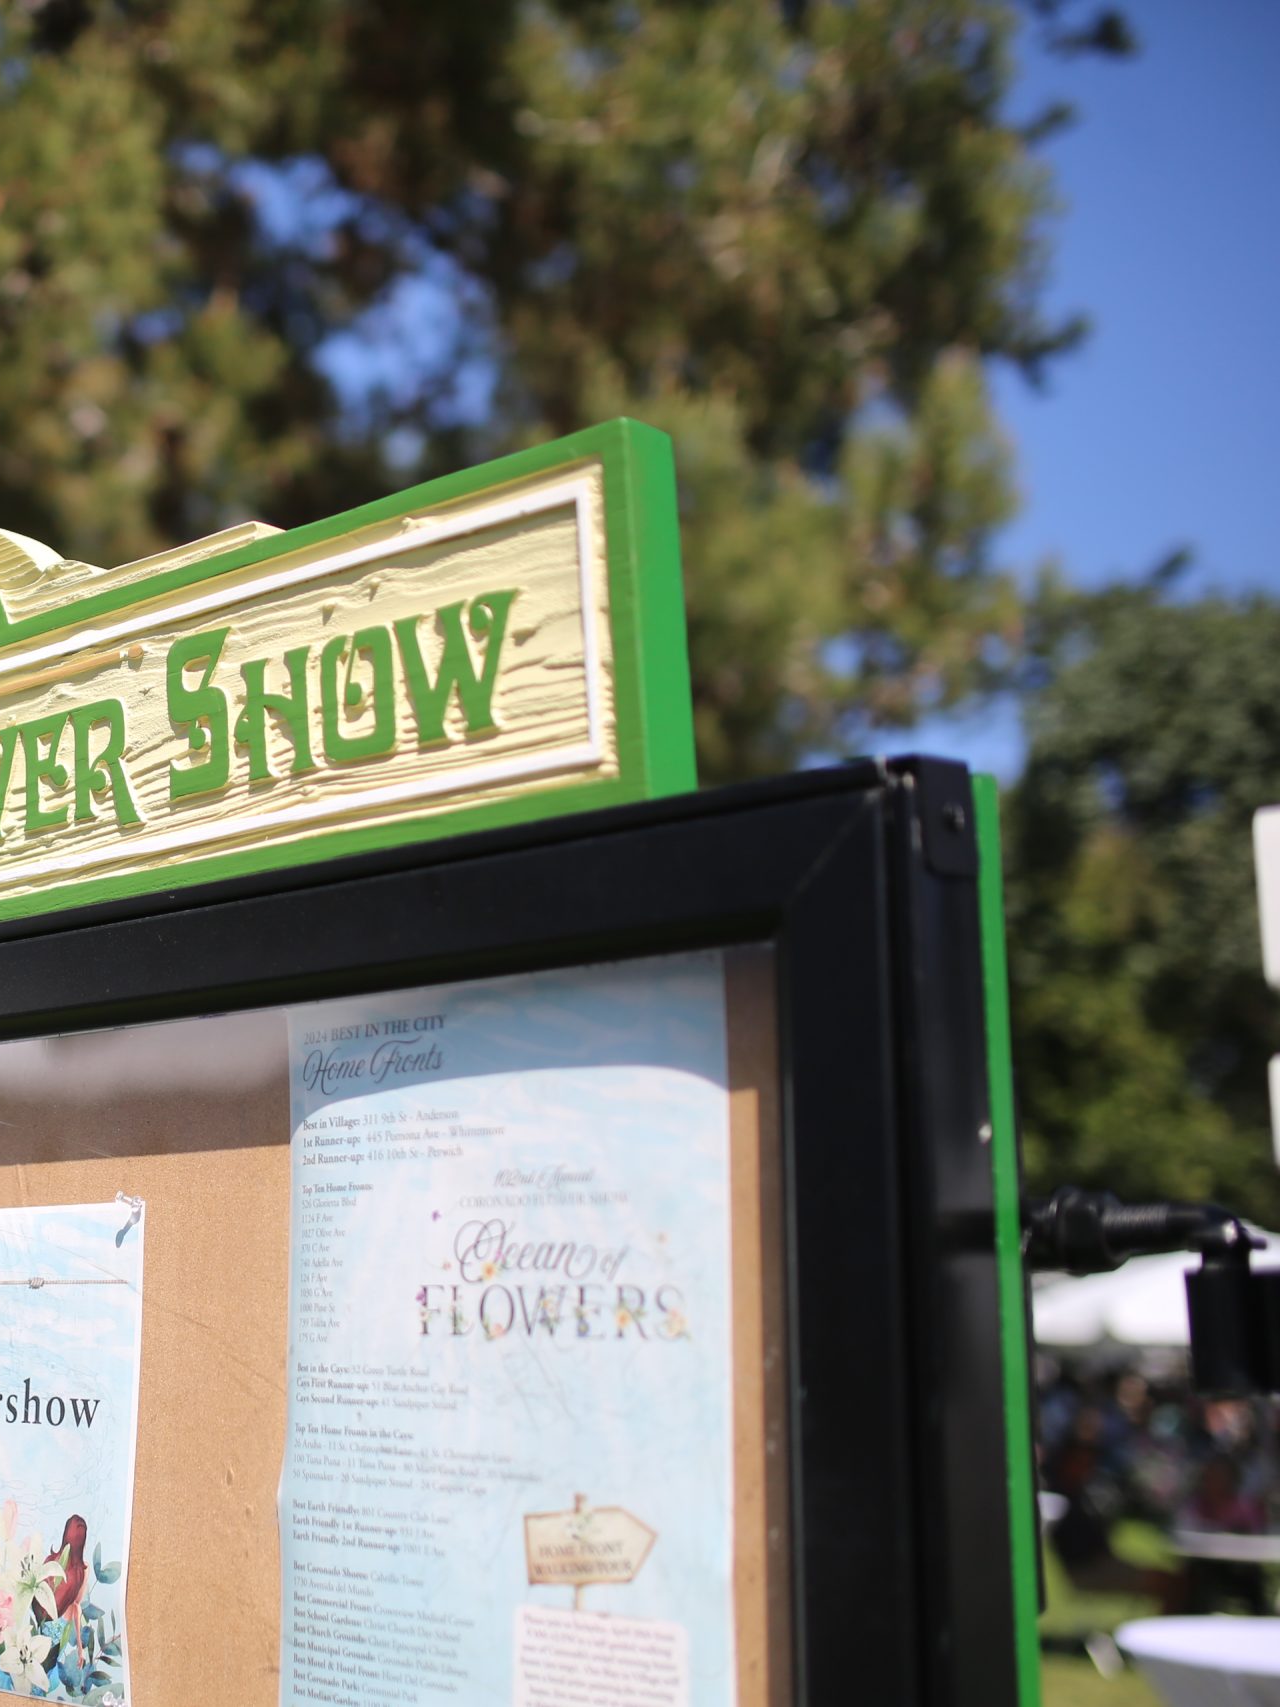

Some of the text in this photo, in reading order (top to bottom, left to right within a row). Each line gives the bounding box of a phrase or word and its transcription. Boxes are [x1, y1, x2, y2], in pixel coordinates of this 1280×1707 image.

[167, 588, 519, 799] SHOW
[304, 1014, 446, 1045] 2024 BEST IN THE CITY
[303, 1036, 443, 1095] Home Fronts
[303, 1119, 318, 1130] Best
[320, 1118, 327, 1128] in
[329, 1115, 360, 1131] Village:
[362, 1113, 378, 1125] 311
[303, 1136, 313, 1147] 1st
[315, 1134, 361, 1148] Runner-up:
[303, 1153, 315, 1165] 2nd
[318, 1151, 364, 1165] Runner-up:
[302, 1184, 312, 1196] Top
[326, 1183, 346, 1192] Home
[454, 1219, 597, 1283] Ocean
[420, 1284, 688, 1341] FLOWERS
